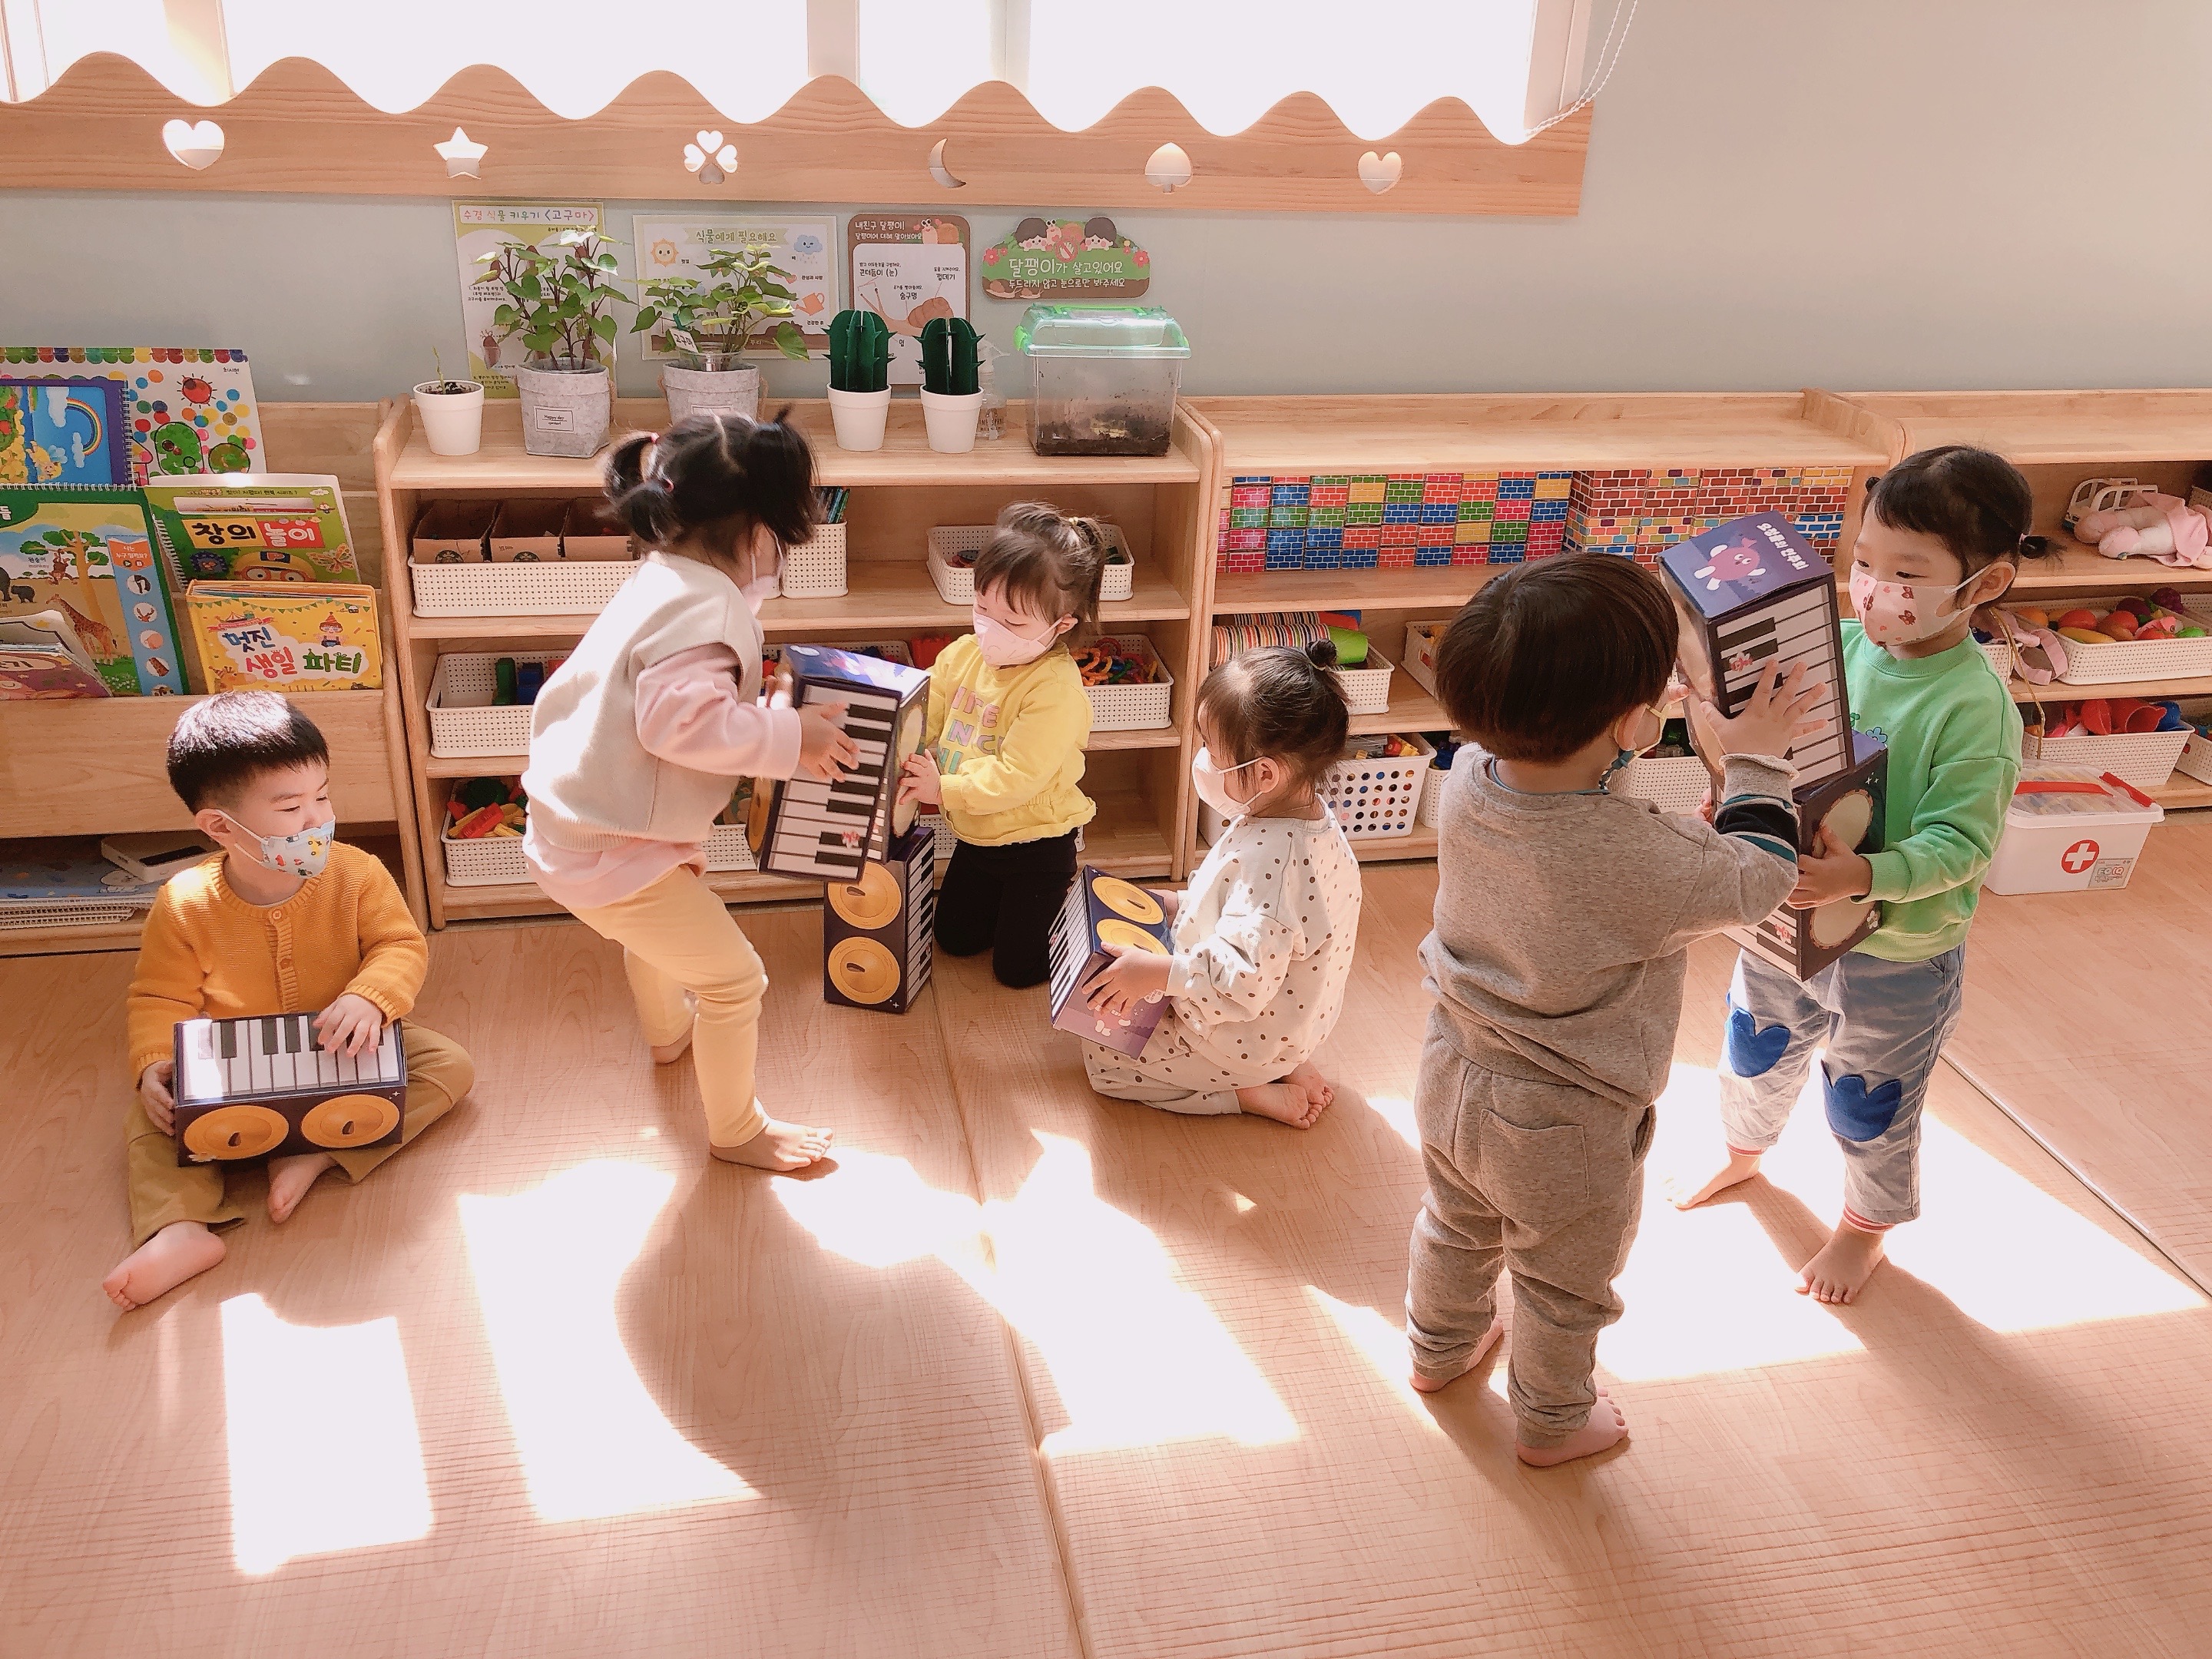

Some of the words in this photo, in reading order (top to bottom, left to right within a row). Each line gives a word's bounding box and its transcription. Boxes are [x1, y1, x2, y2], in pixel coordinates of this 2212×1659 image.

[464, 210, 482, 220] 수경
[487, 210, 506, 222] 식물
[510, 210, 539, 220] 키우기
[545, 209, 594, 221] <고구마>
[855, 220, 876, 230] 내친구
[696, 229, 735, 244] 식물에게
[738, 230, 777, 244] 필요해요
[1008, 258, 1068, 278] 달팽이가
[1072, 261, 1123, 275] 살고있어요
[1008, 279, 1040, 289] 두드리지
[1043, 278, 1058, 290] 않고
[1061, 279, 1090, 289] 눈으로만
[1094, 278, 1125, 288] 봐주세요
[674, 333, 694, 349] 고구마
[192, 522, 257, 545] 창의
[263, 522, 316, 547] 놀이
[222, 627, 276, 653] 멋진
[246, 647, 297, 679] 생일
[303, 648, 363, 674] 파티
